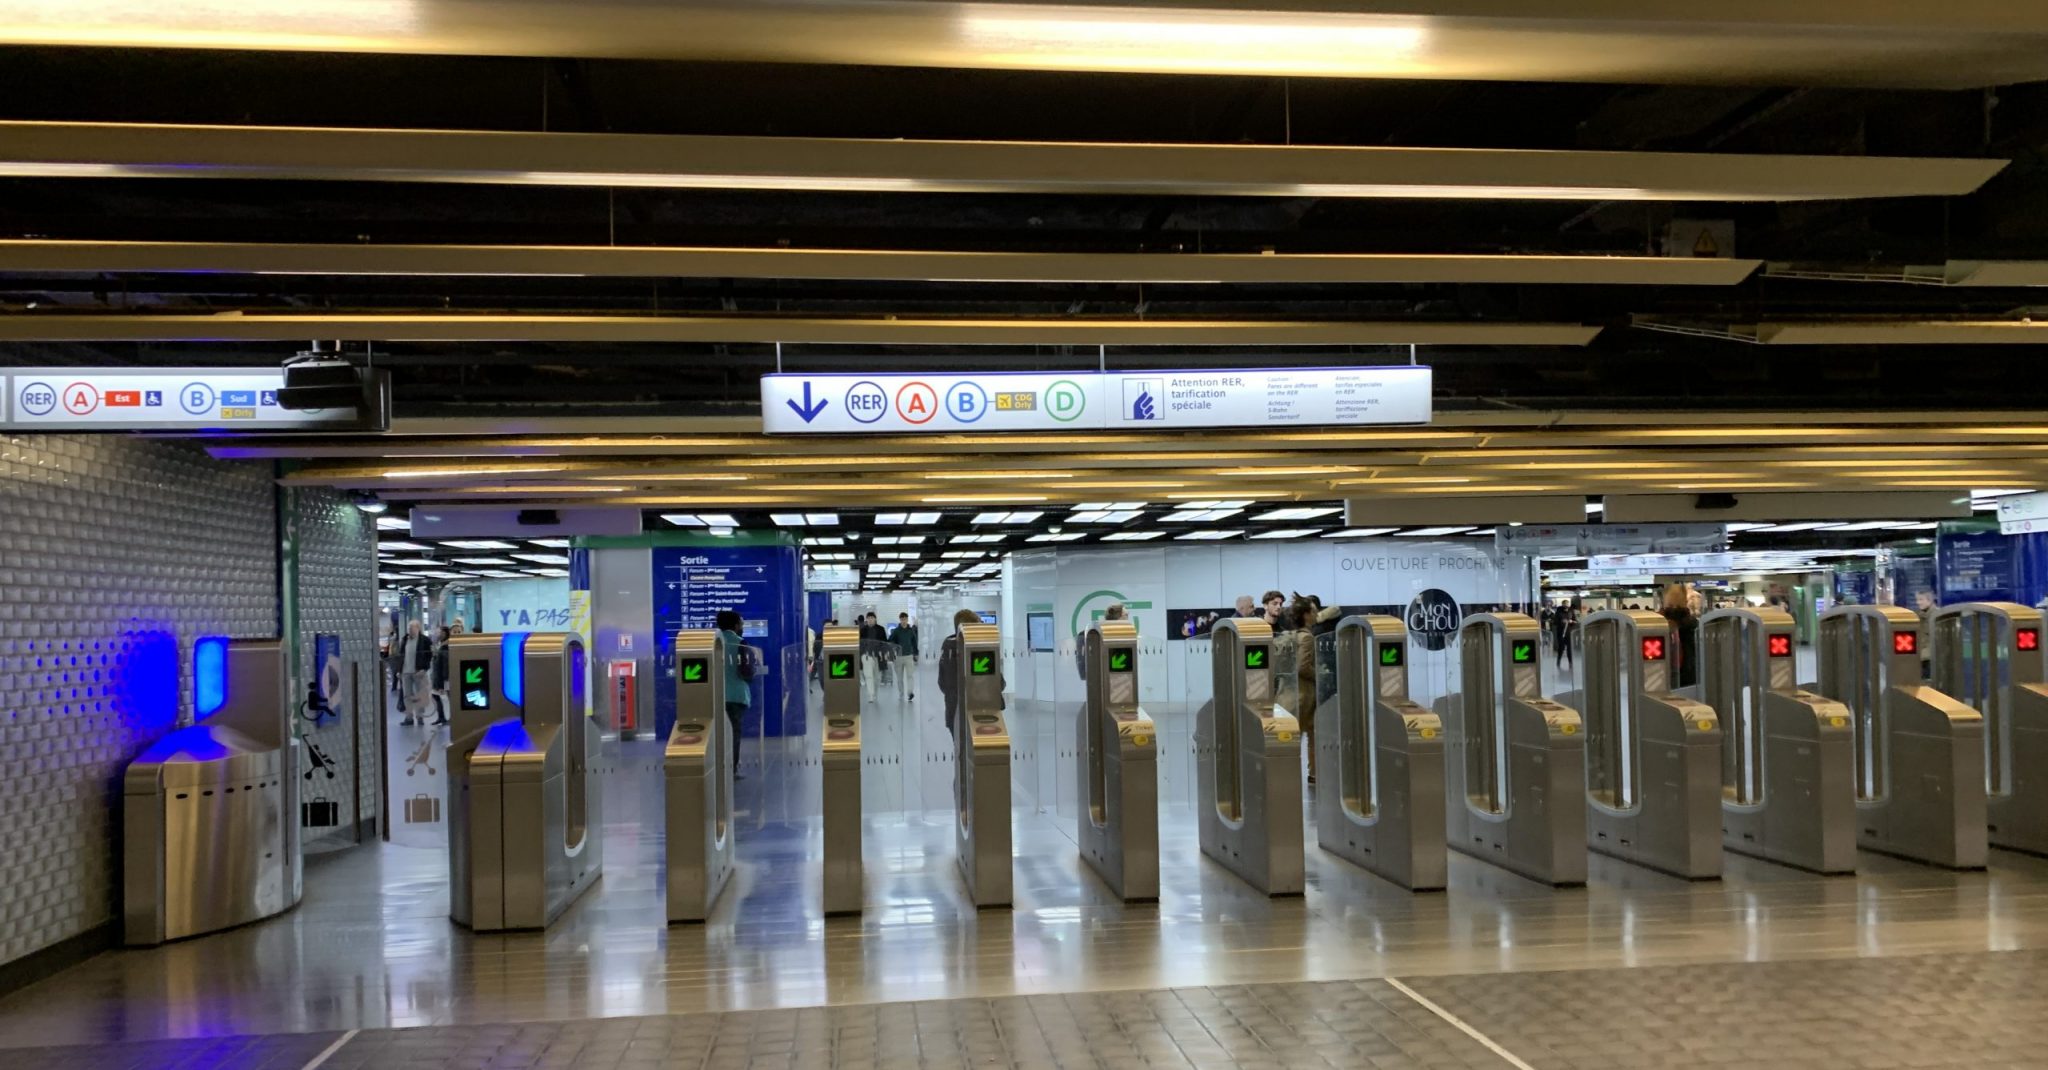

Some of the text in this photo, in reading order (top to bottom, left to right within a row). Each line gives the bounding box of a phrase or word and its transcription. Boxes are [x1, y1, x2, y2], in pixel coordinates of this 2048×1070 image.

[1171, 377, 1245, 388] Attention RER,
[25, 392, 51, 406] RER
[115, 393, 130, 403] Est
[1171, 388, 1226, 398] tarification
[851, 394, 882, 410] RER
[1014, 393, 1032, 402] CDG
[1171, 400, 1212, 411] spéciale
[680, 556, 709, 565] Sortie
[1420, 602, 1450, 618] MON
[499, 609, 531, 626] Y'A
[534, 608, 570, 627] PAS
[1410, 612, 1458, 631] CHOU
